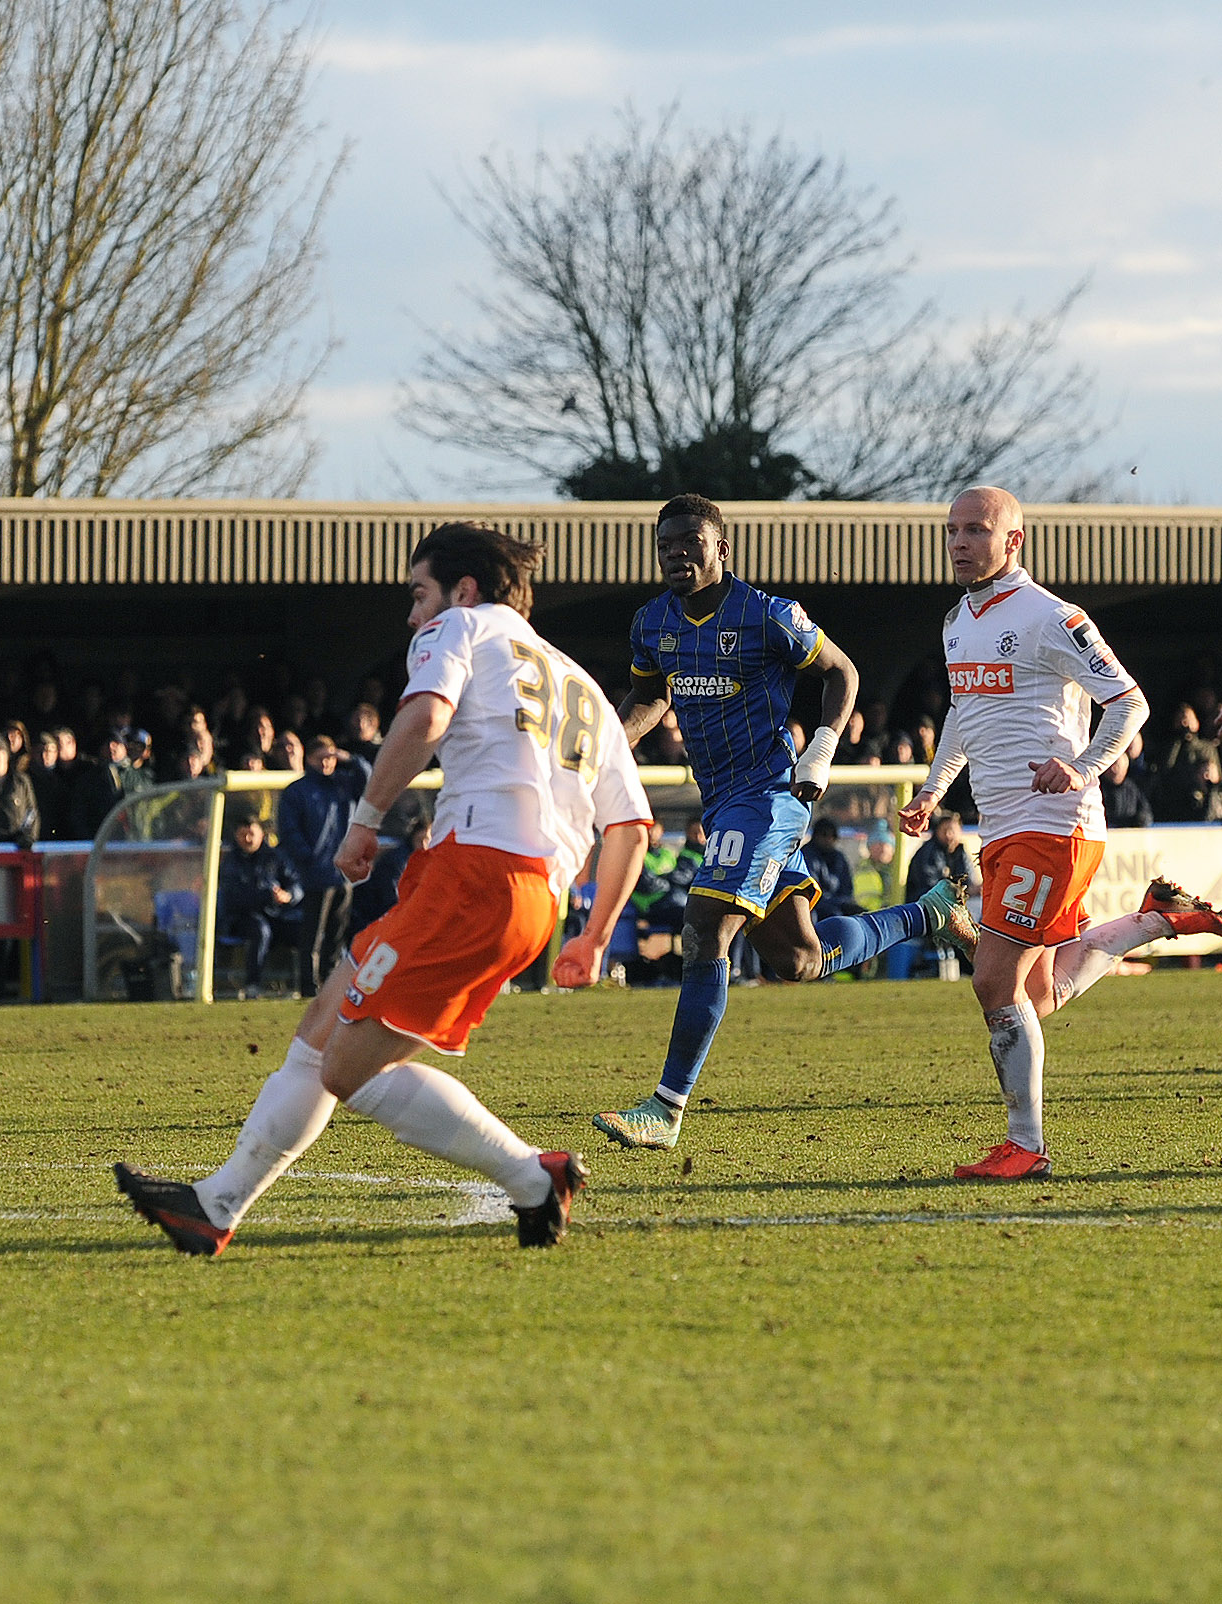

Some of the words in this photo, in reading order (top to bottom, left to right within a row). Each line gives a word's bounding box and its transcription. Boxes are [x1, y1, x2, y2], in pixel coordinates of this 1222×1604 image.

[671, 676, 734, 687] FOOTBALL
[673, 685, 734, 696] MANAGER
[948, 665, 1012, 692] asyJet
[510, 639, 604, 784] 38
[704, 829, 745, 867] 40
[1093, 852, 1162, 883] ANK
[1001, 864, 1054, 918] 21
[1007, 911, 1034, 927] FILA
[355, 942, 398, 995] 8
